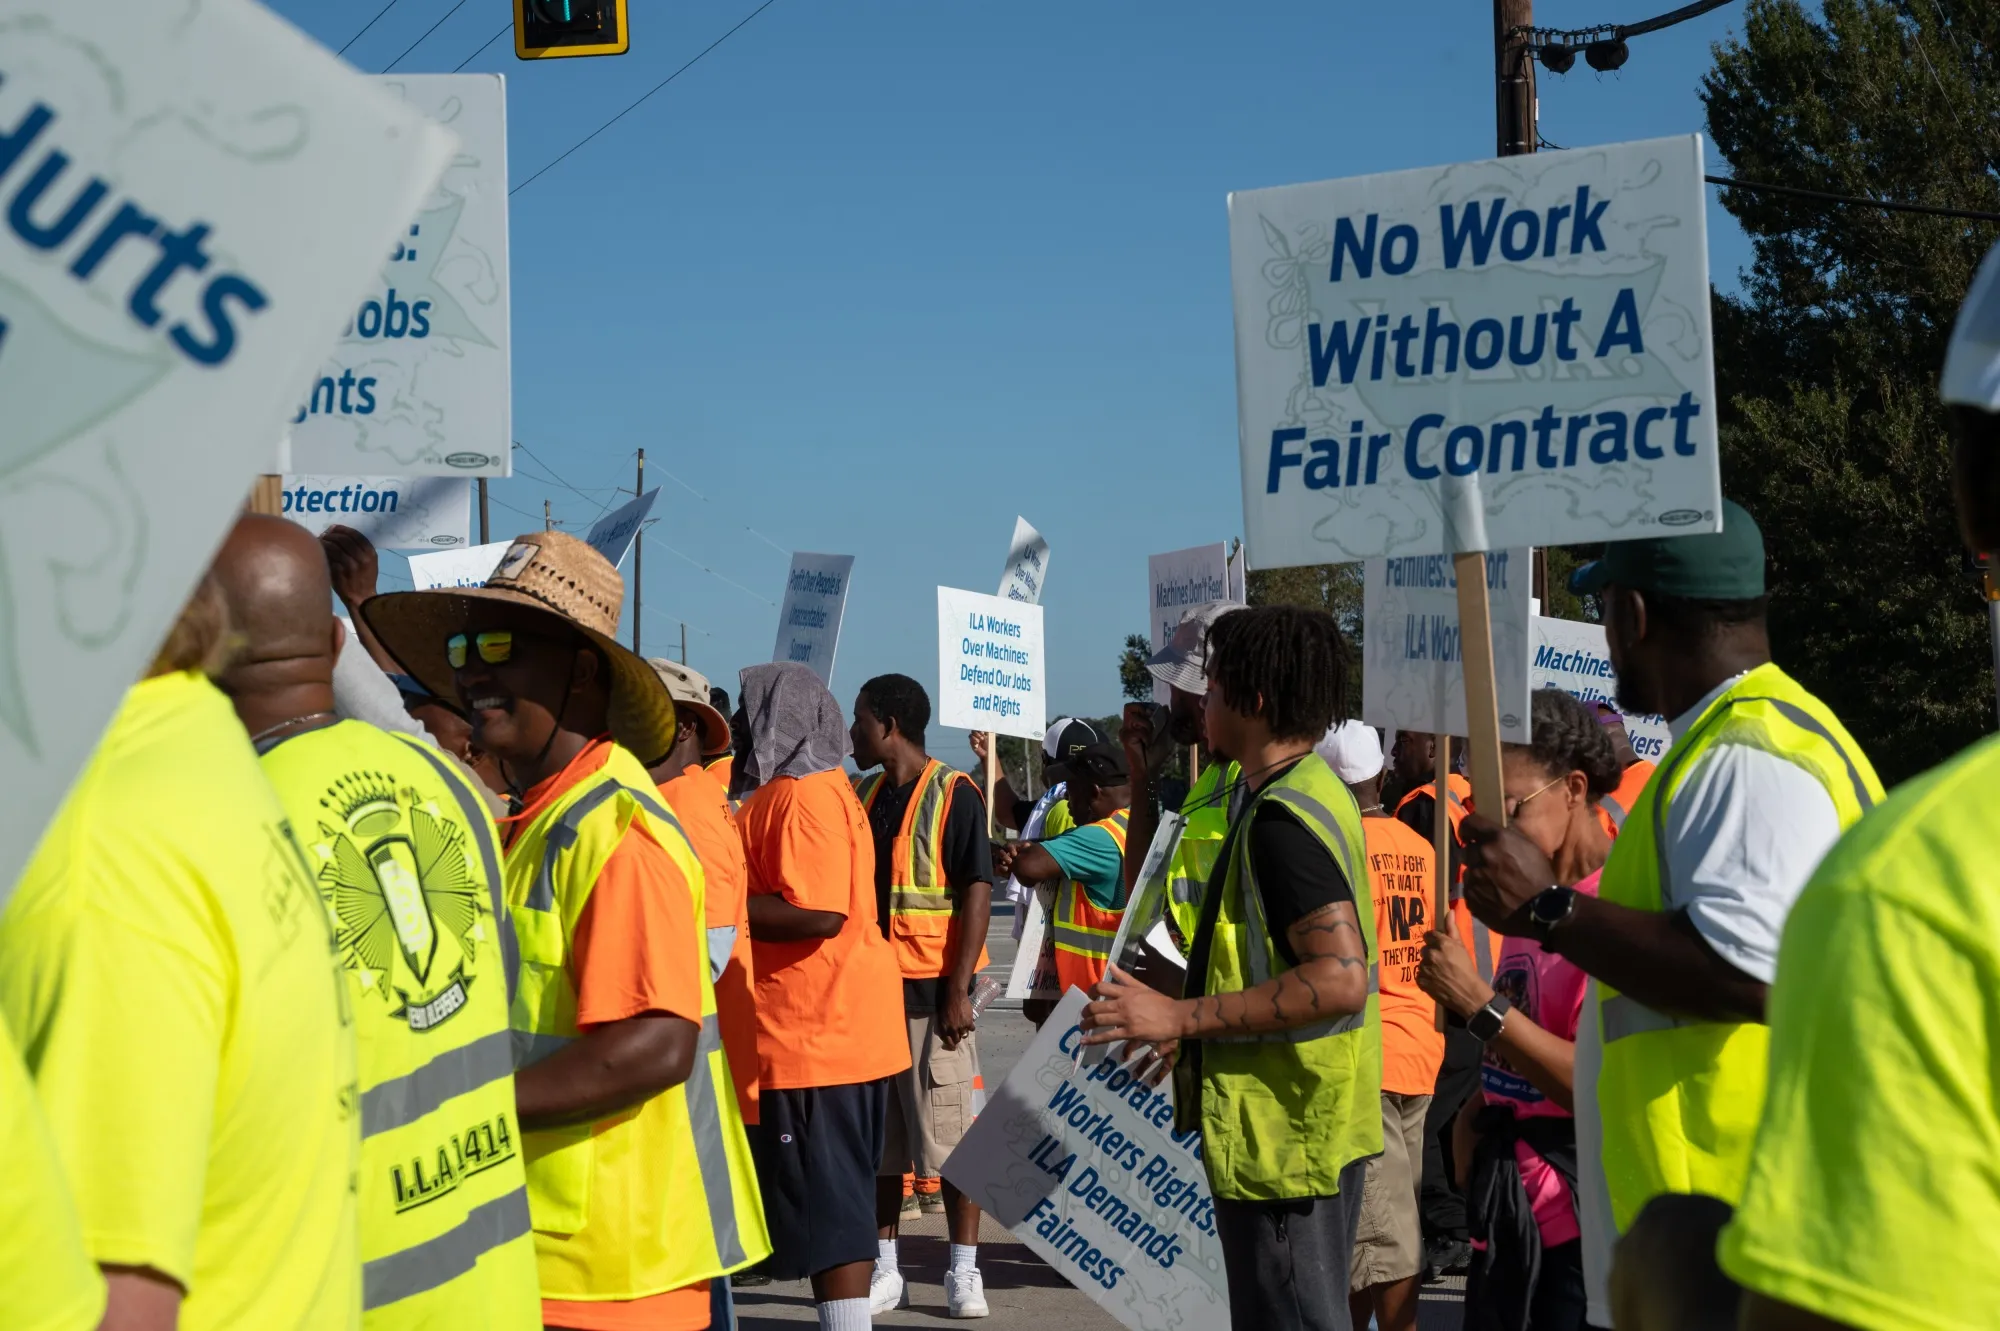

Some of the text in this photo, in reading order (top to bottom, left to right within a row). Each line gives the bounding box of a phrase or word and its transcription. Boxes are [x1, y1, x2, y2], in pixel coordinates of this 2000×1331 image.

[1329, 185, 1611, 282] No Work
[341, 289, 431, 338] obs
[1307, 288, 1645, 387] Without A
[1266, 391, 1700, 494] Fair Contract
[281, 484, 399, 513] otection
[969, 612, 1021, 638] ILA Workers
[1405, 613, 1427, 660] ILA
[962, 637, 1029, 666] Over Machines:
[960, 663, 1031, 692] Defend Our Jobs
[973, 693, 1021, 717] and Rights
[1628, 730, 1663, 756] kers
[1059, 1024, 1174, 1129] Cporate
[1048, 1080, 1145, 1171] Workers
[1028, 1134, 1183, 1268] ILA Demands
[1023, 1197, 1125, 1289] Fairness
